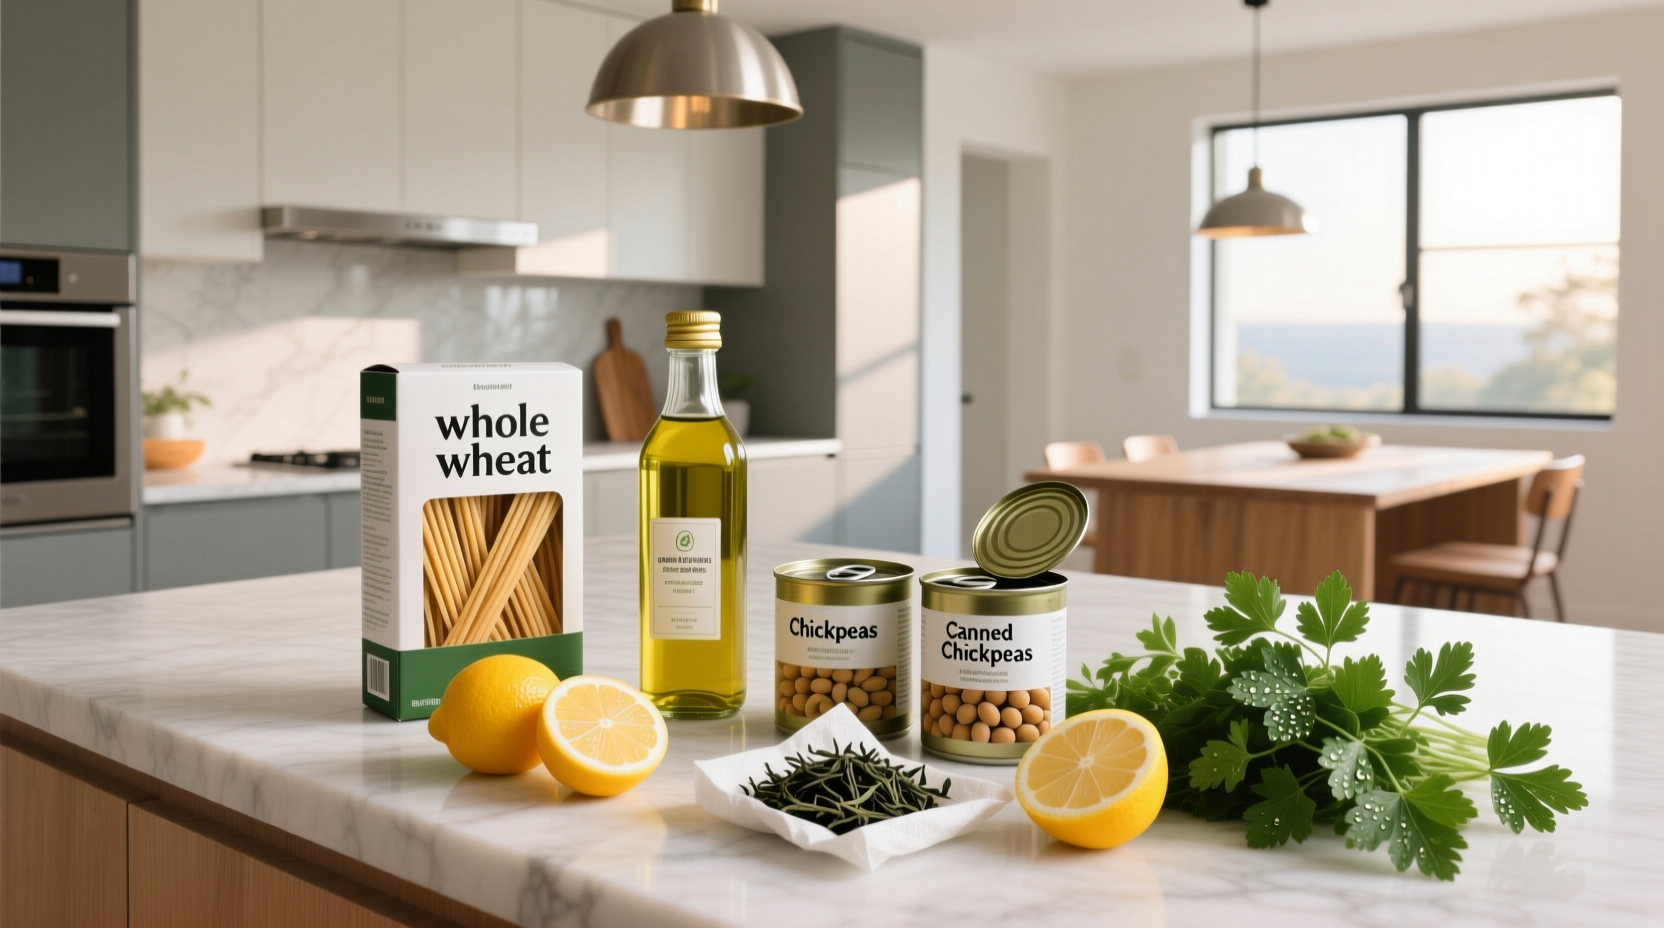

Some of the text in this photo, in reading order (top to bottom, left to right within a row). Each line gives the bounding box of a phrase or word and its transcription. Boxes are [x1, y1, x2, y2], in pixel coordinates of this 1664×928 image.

[434, 402, 549, 441] whole
[435, 442, 552, 479] wheat
[789, 616, 878, 644] Chickpeas
[945, 620, 1013, 642] Canned
[941, 640, 1033, 668] Chickpeas
